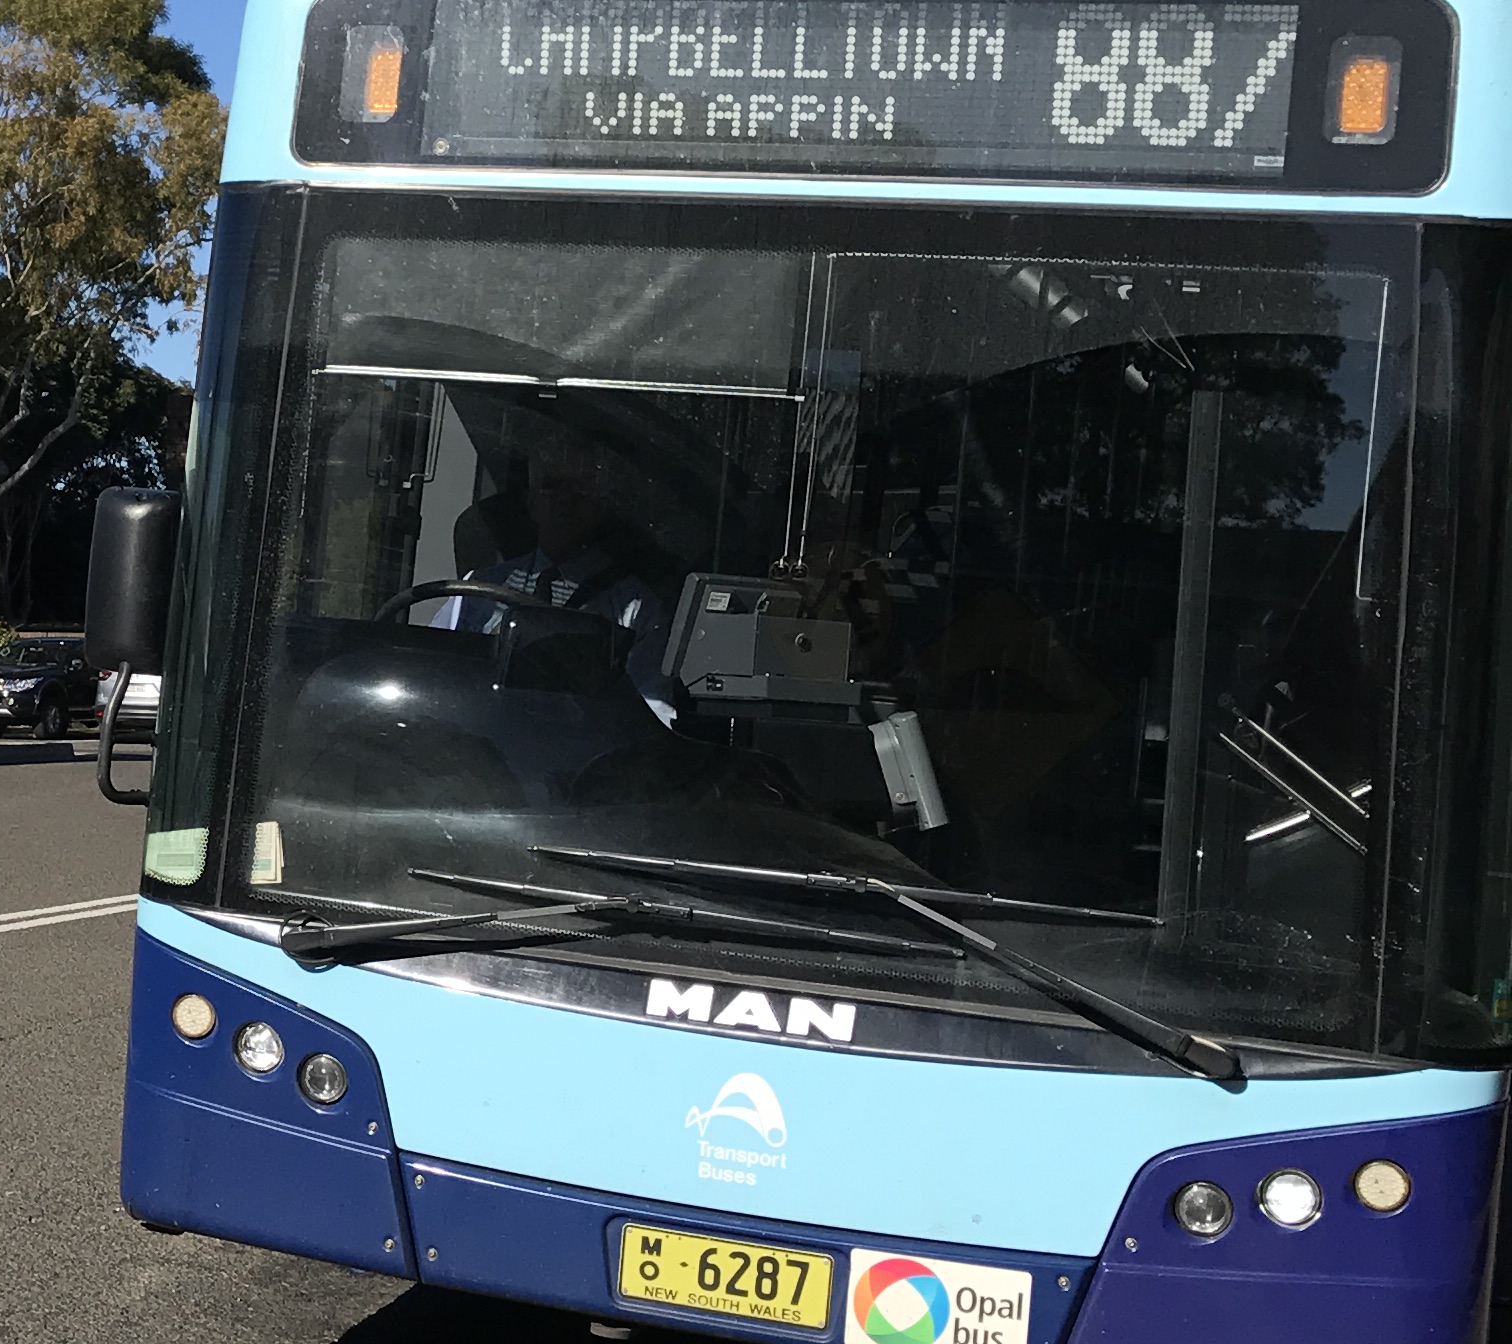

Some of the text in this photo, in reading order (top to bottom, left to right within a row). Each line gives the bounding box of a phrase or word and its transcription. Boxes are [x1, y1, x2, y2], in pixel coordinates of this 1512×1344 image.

[501, 1, 1300, 147] CAMPBELLTOWN 887
[586, 91, 896, 141] VIA APPIN
[646, 979, 856, 1042] MAN
[697, 1139, 787, 1169] Transport
[698, 1161, 757, 1186] Buses
[697, 1247, 810, 1306] 6287
[644, 1286, 802, 1322] NEW SOUTH WALES
[956, 1287, 1024, 1322] Opal
